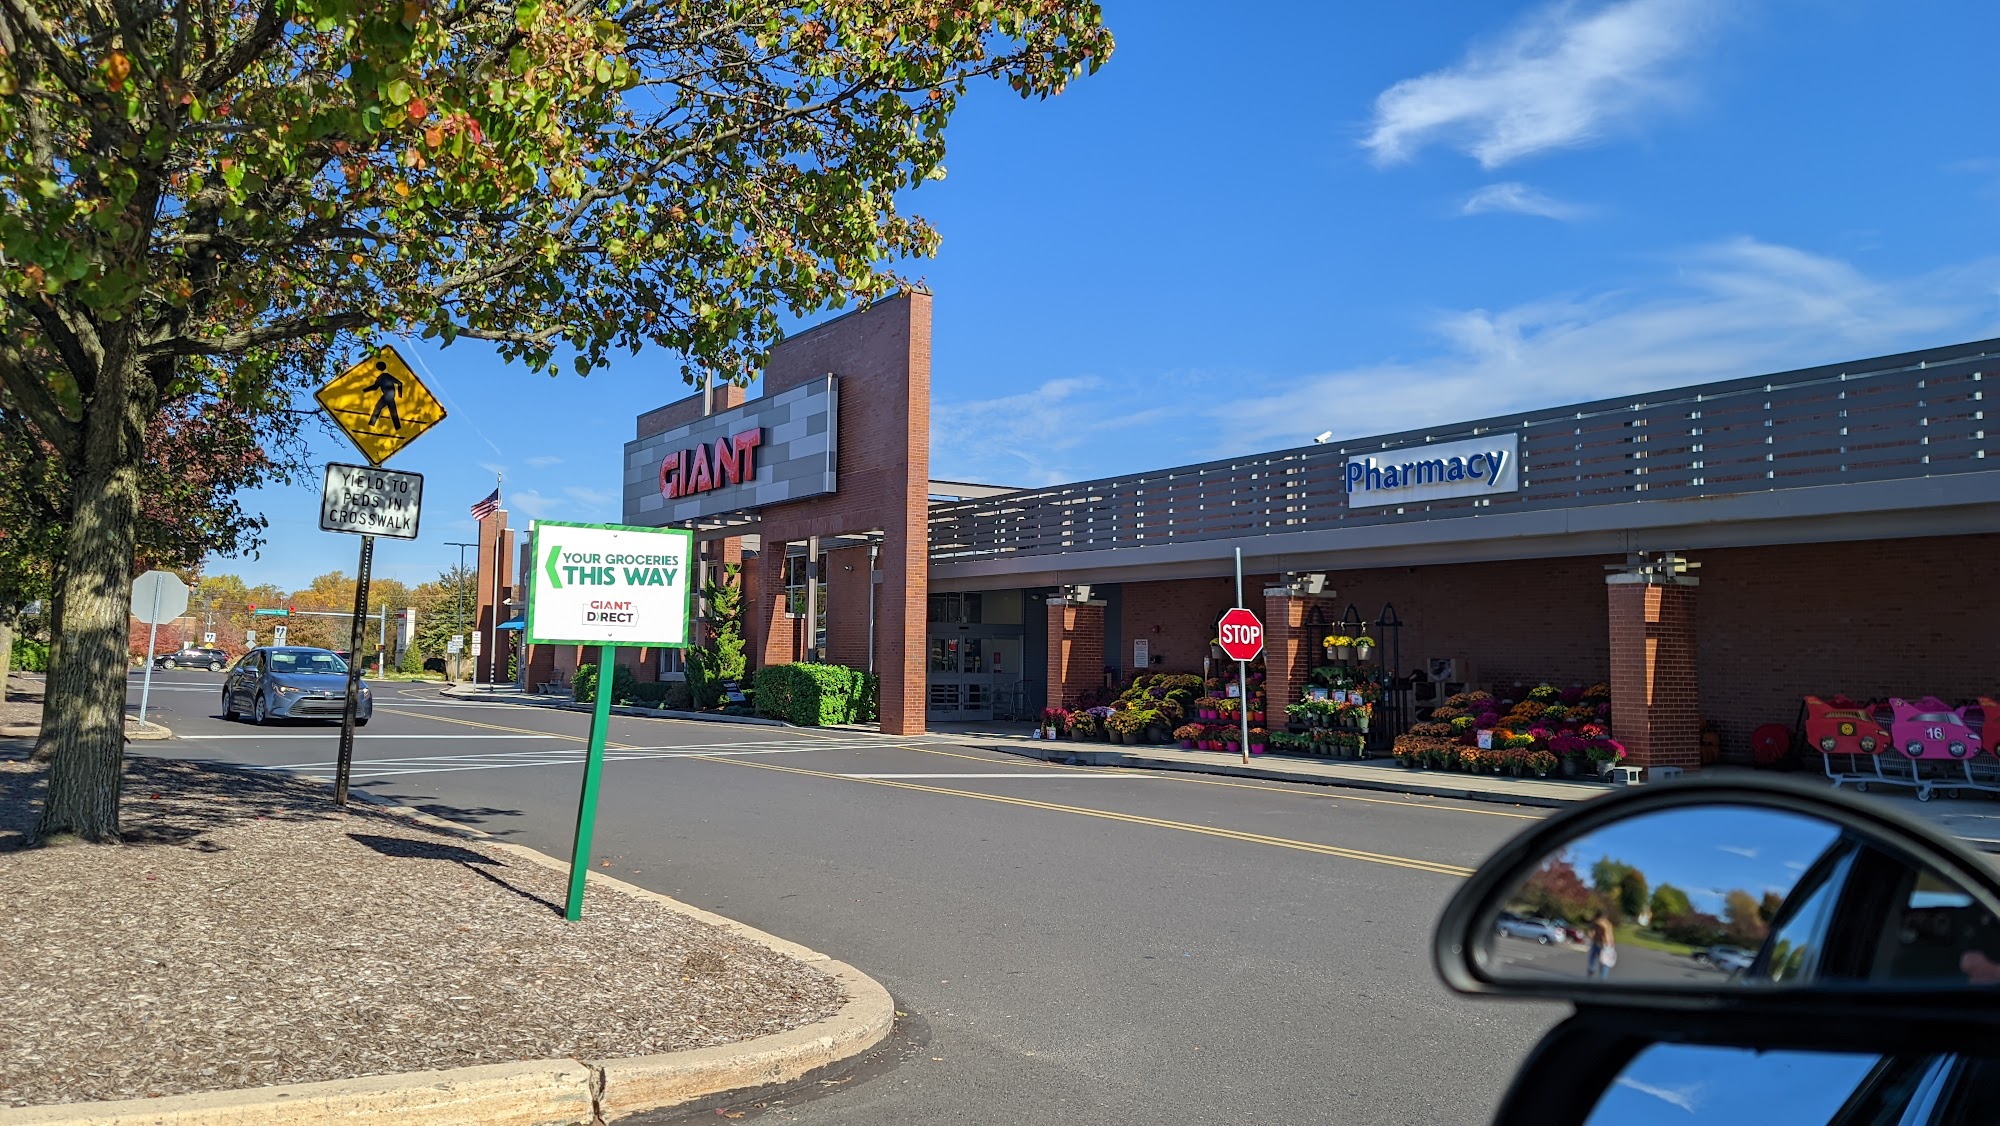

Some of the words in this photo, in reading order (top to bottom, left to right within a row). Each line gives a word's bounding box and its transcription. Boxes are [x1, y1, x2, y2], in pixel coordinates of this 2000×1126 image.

[659, 427, 765, 499] GIANT
[1346, 450, 1508, 493] Pharmacy
[343, 474, 382, 488] YIELD
[393, 480, 407, 493] TO
[344, 493, 380, 507] PEDS
[388, 497, 402, 510] IN
[329, 510, 410, 529] CROSSWALK
[562, 553, 601, 564] YOUR
[605, 554, 679, 566] GROCERIES
[562, 565, 616, 586] THIS
[623, 567, 678, 587] WAY
[590, 600, 632, 611] GIANT
[1222, 624, 1260, 644] STOP
[1926, 728, 1942, 739] 16
